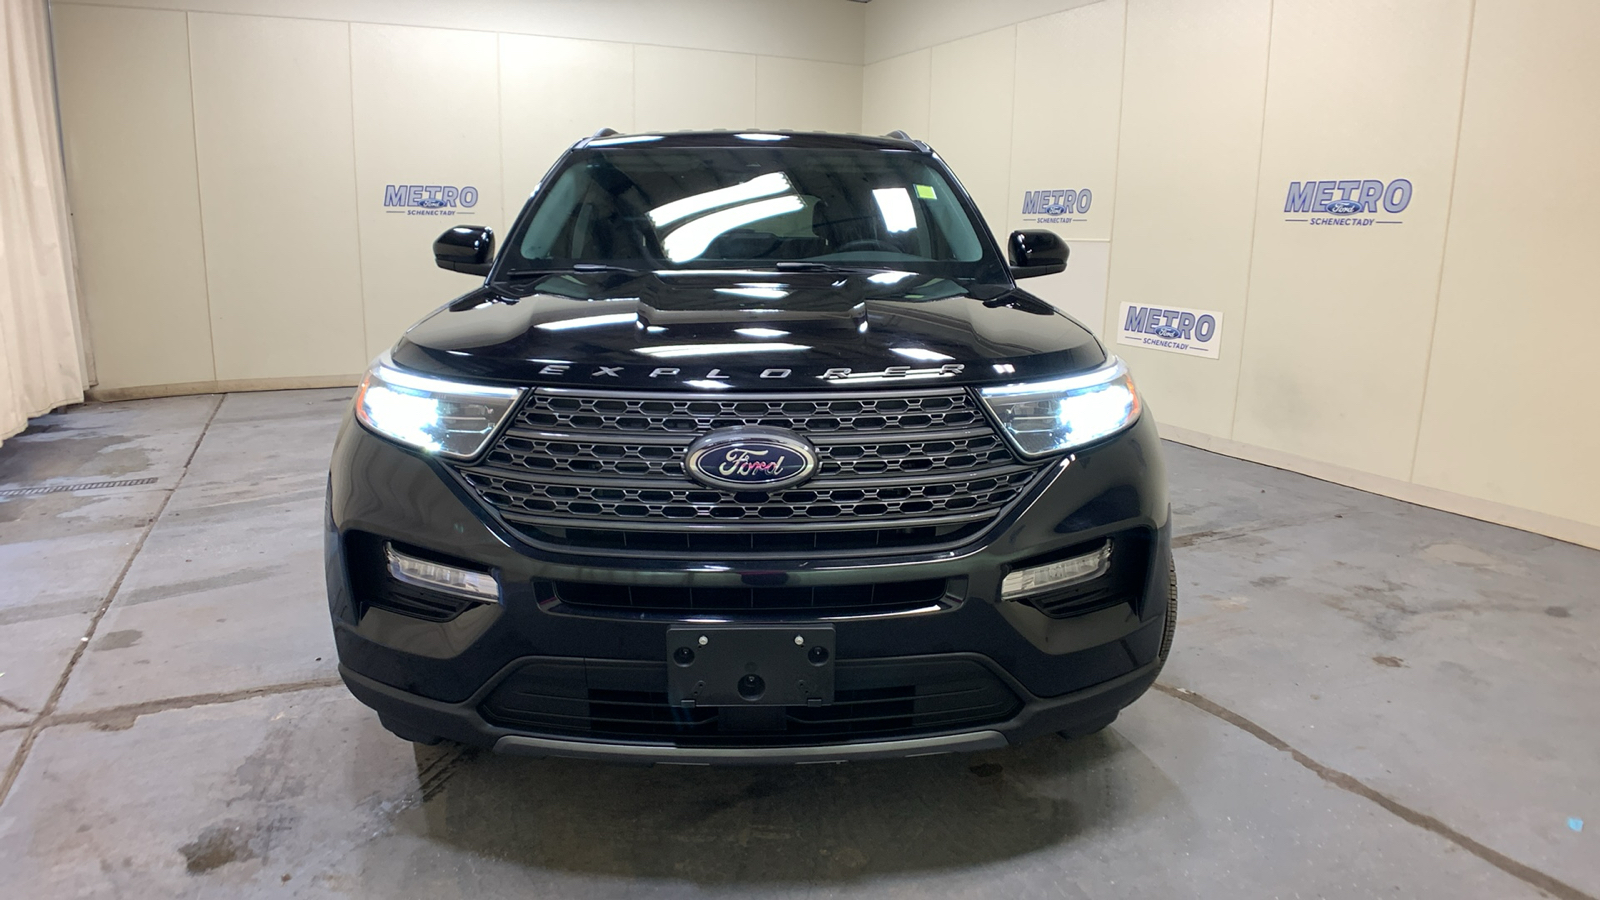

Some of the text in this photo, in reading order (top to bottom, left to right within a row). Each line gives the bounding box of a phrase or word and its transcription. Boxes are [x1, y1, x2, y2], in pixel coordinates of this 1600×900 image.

[383, 184, 479, 208] METRO
[1022, 188, 1092, 214] METRO
[1284, 178, 1413, 213] METRO
[1331, 202, 1356, 214] Ford
[1309, 217, 1375, 226] SCHENECTADY
[1124, 305, 1216, 342] METRO
[1142, 337, 1189, 350] SCHENECTADY
[537, 363, 965, 380] EXPLORER
[718, 448, 786, 476] Ford
